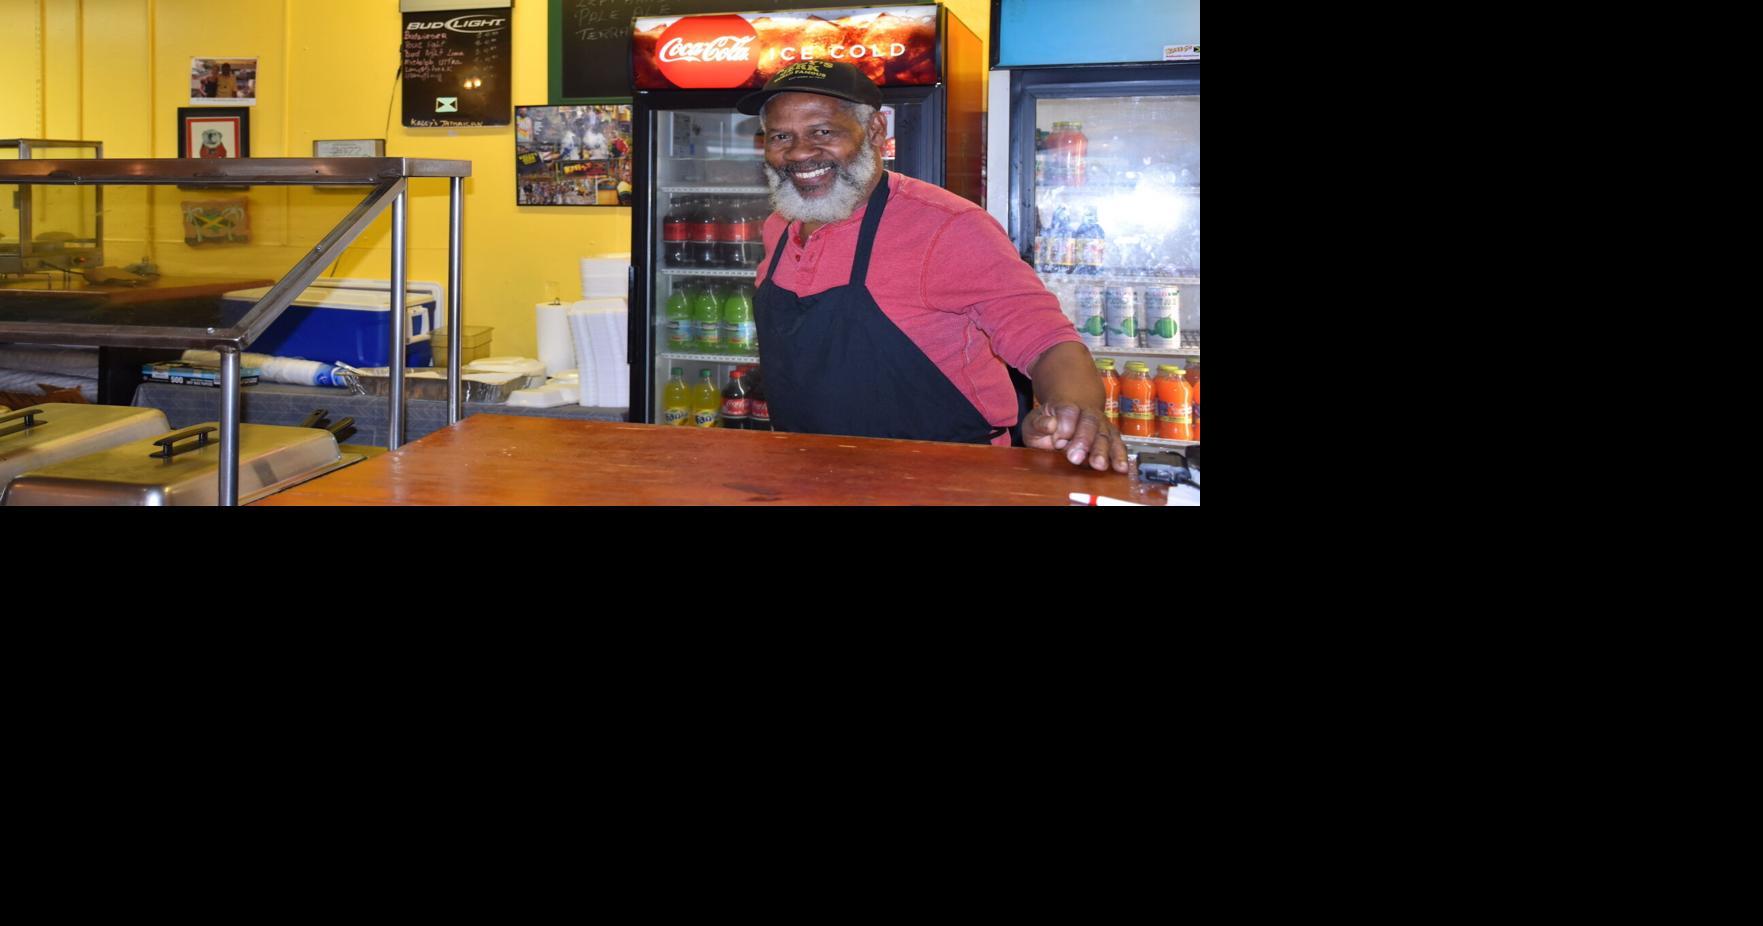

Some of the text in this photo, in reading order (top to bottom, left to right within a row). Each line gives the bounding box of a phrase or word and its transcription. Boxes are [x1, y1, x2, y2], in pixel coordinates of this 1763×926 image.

[407, 19, 506, 30] BUD LIGHT
[769, 42, 906, 61] ICE COLD
